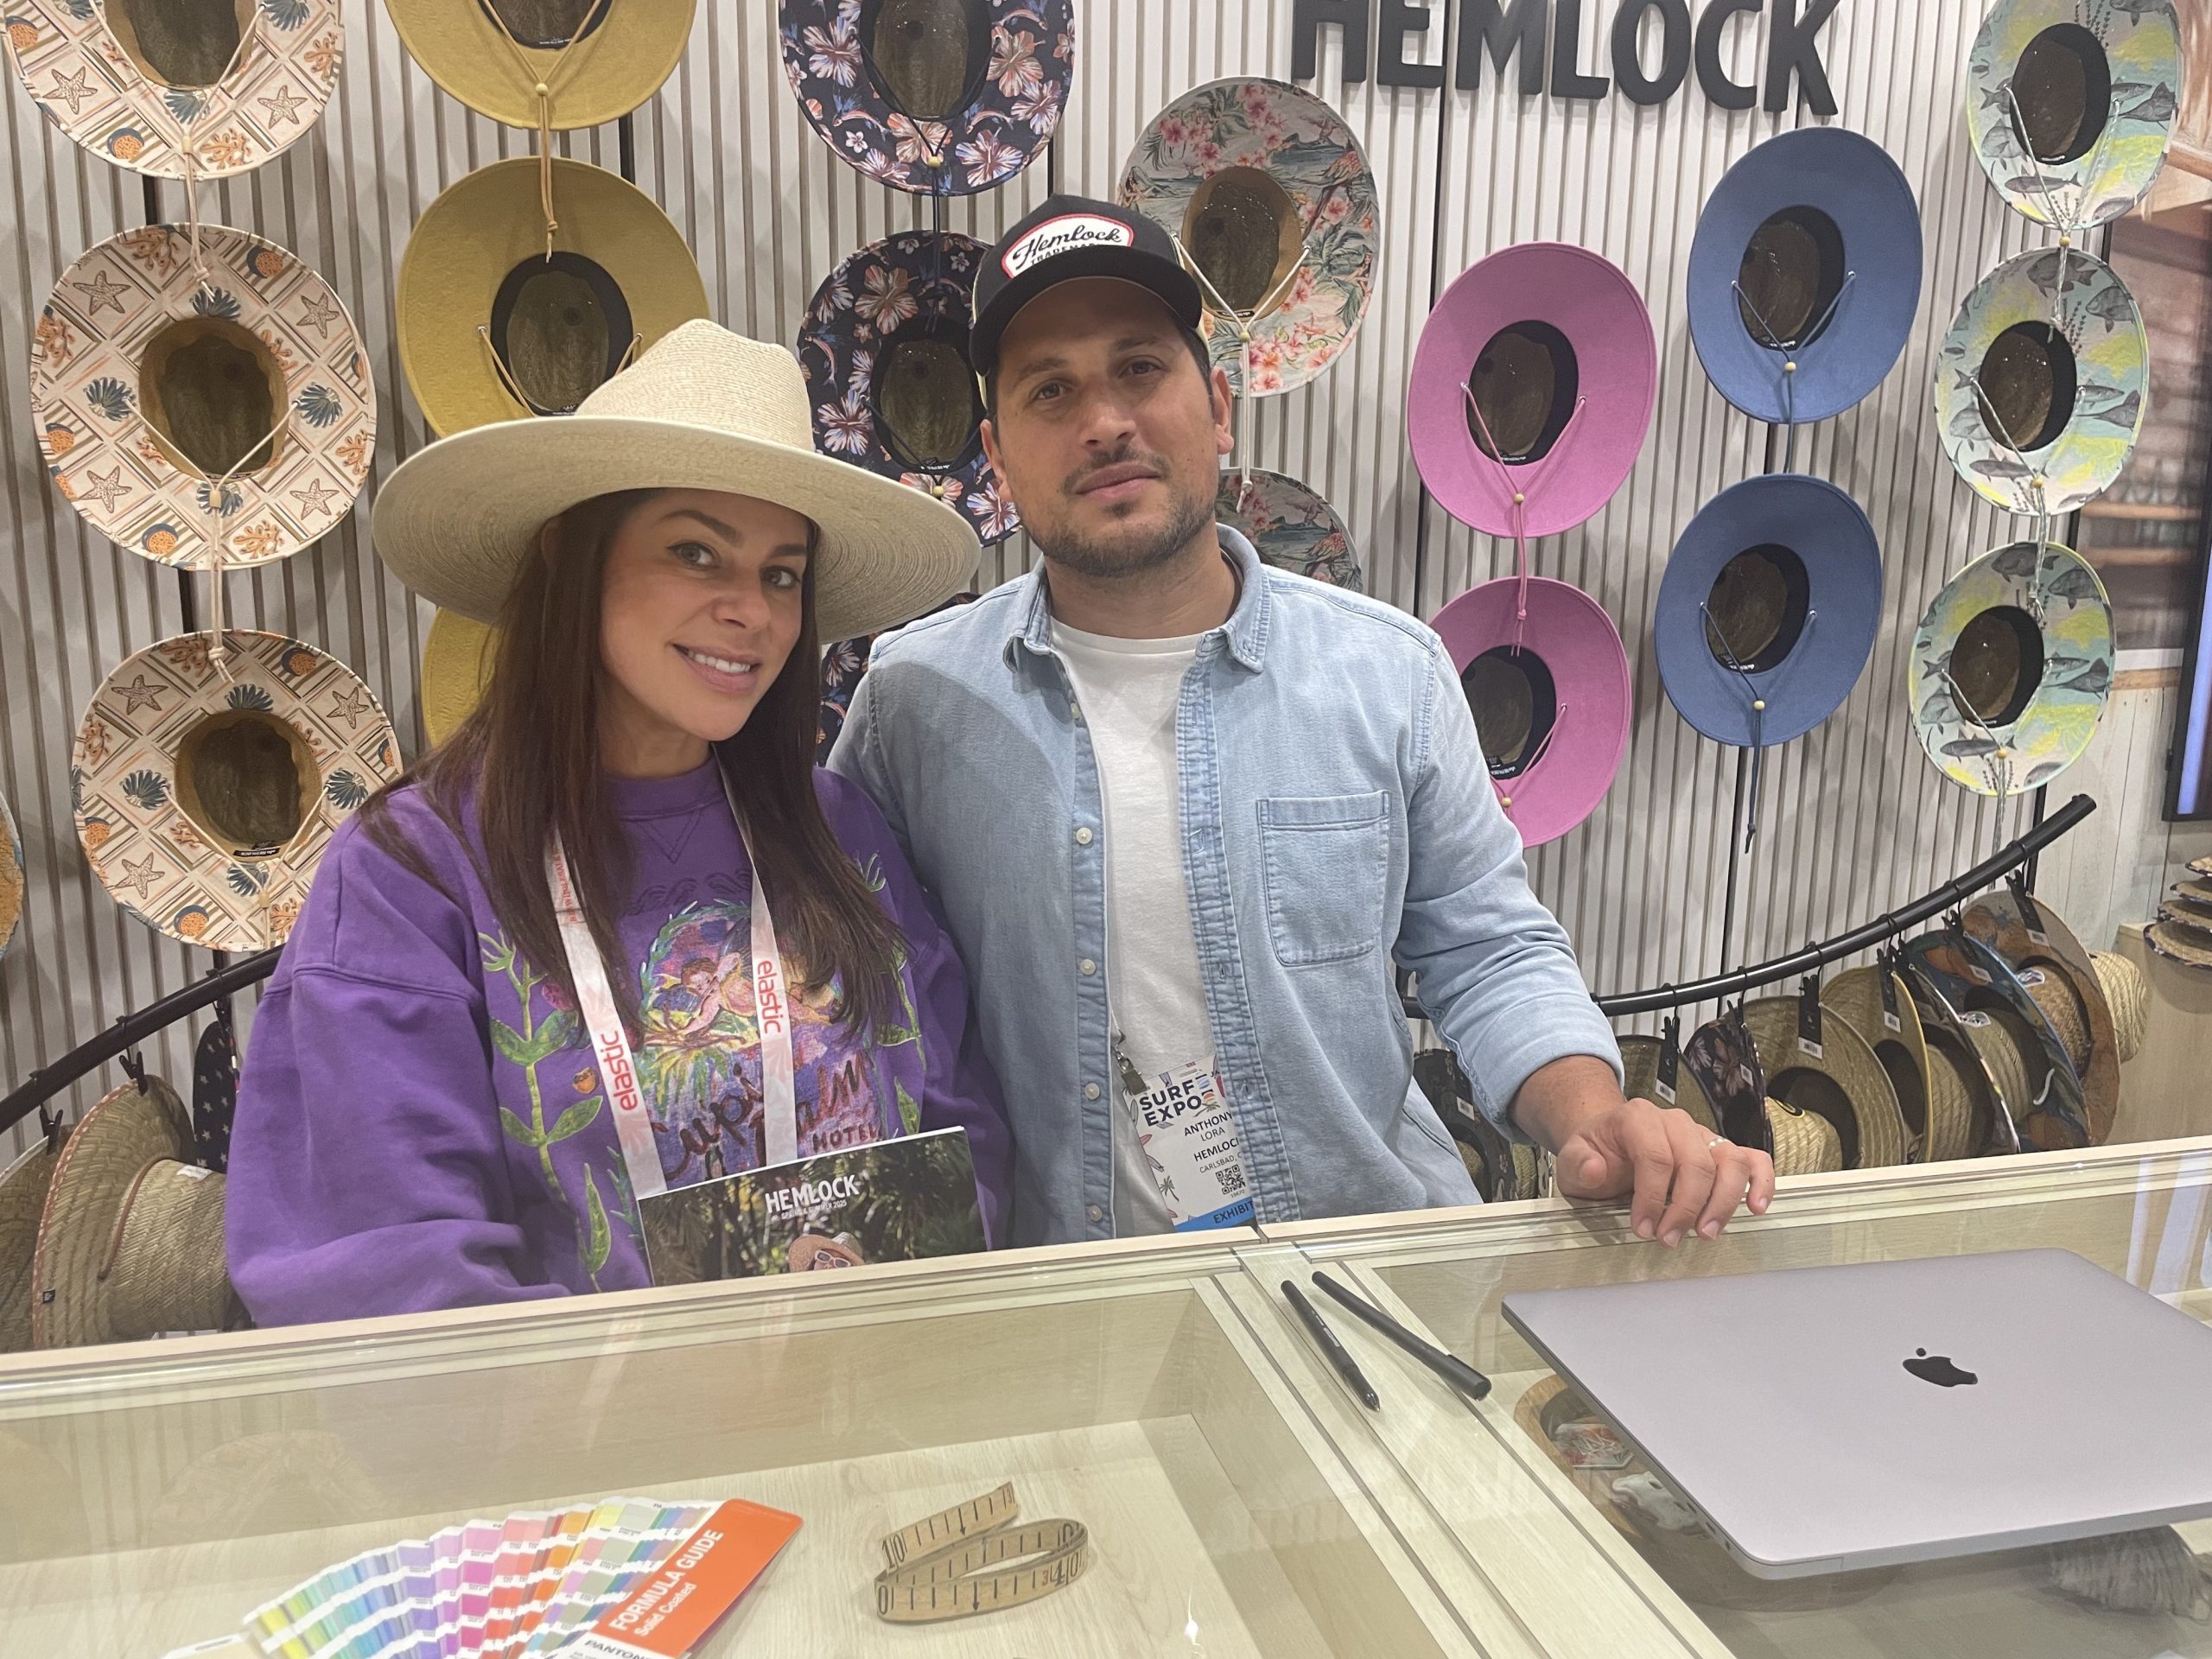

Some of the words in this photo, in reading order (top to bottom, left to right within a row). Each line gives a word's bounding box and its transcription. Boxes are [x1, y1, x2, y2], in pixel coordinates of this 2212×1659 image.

[1291, 0, 1839, 115] HEMLOCK
[1013, 225, 1122, 270] Hemlock
[757, 960, 784, 1034] elastic
[600, 1030, 639, 1111] elastic
[1139, 1079, 1194, 1111] SURF
[1144, 1095, 1202, 1127] EXPO
[1184, 1111, 1233, 1136] ANTHONY
[1200, 1127, 1226, 1141] LORA
[1199, 1154, 1237, 1173] CARLSBAD,
[765, 1174, 860, 1214] HEMLOCK
[608, 1571, 687, 1631] FORMULA
[676, 1529, 725, 1569] GUIDE
[633, 1612, 665, 1637] Solid
[658, 1582, 697, 1613] Coated
